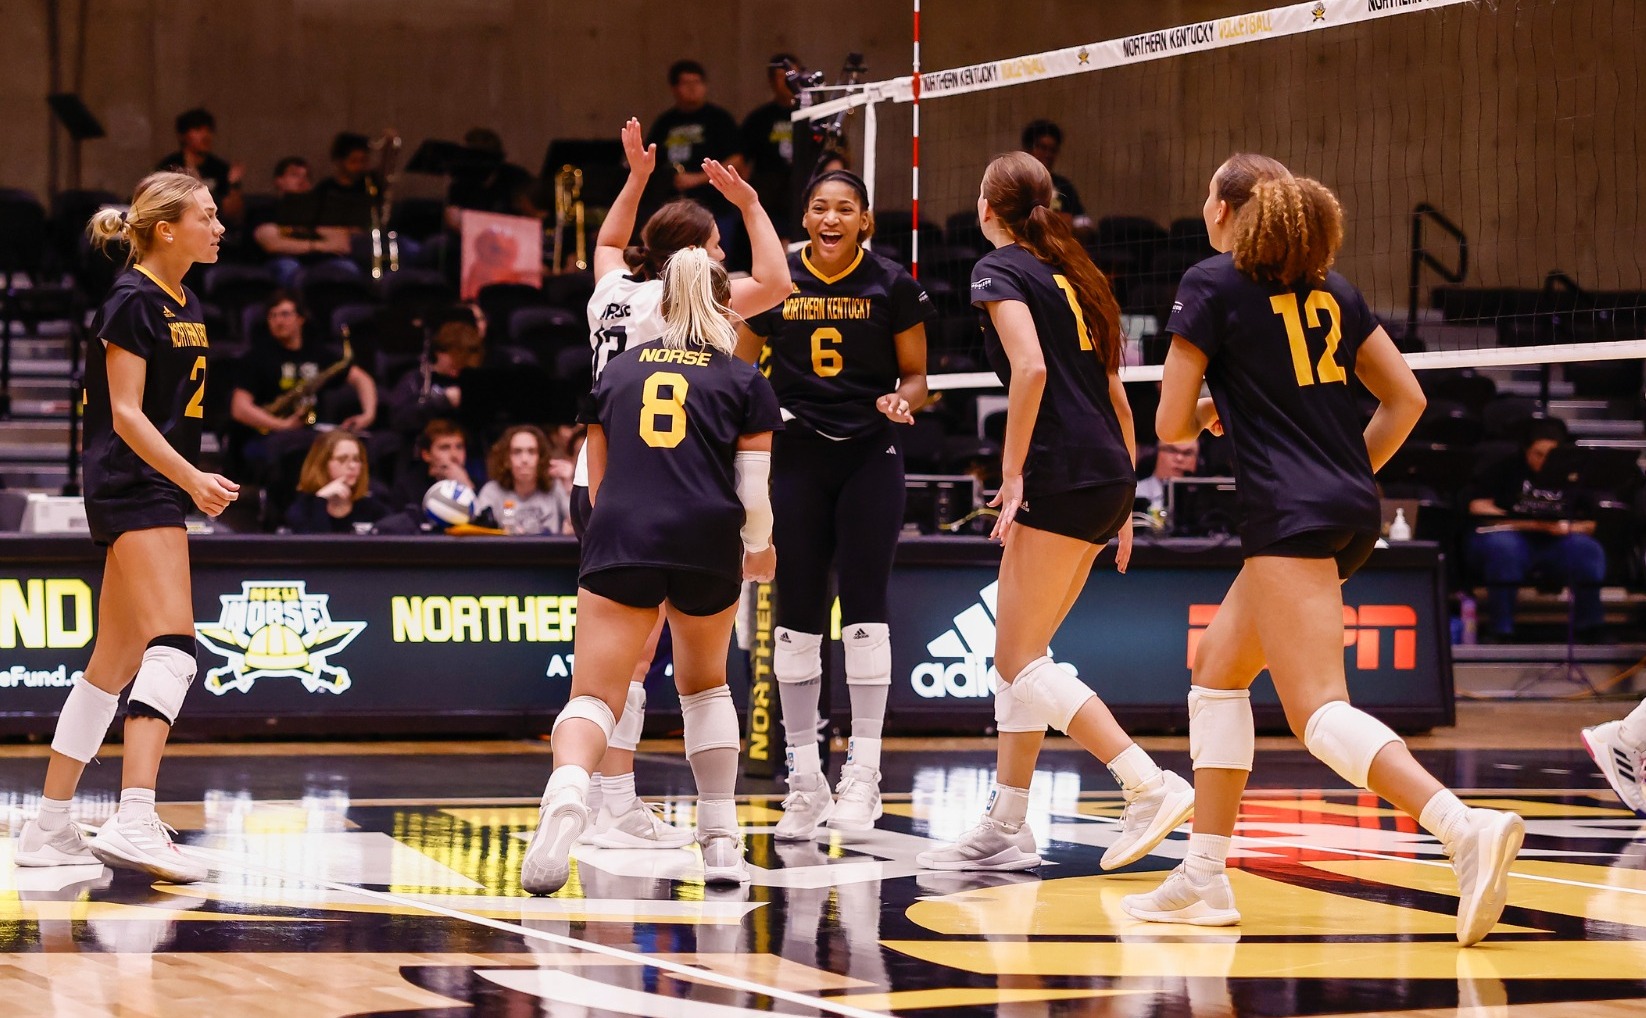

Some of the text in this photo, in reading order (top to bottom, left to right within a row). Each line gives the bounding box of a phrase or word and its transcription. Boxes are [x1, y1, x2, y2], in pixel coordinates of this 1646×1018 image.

[1122, 13, 1273, 57] NORTHERN KENTUCKY VOLLEYBALL
[960, 64, 998, 86] KENTUCKY
[782, 297, 872, 321] NORTHERN KENTUCKY
[638, 348, 713, 368] NORSE
[811, 327, 843, 378] 6
[1269, 290, 1347, 387] 12
[184, 355, 207, 419] 2
[639, 371, 690, 449] 8
[249, 586, 300, 601] NKU
[224, 600, 328, 636] NORSE
[910, 652, 1080, 699] adi
